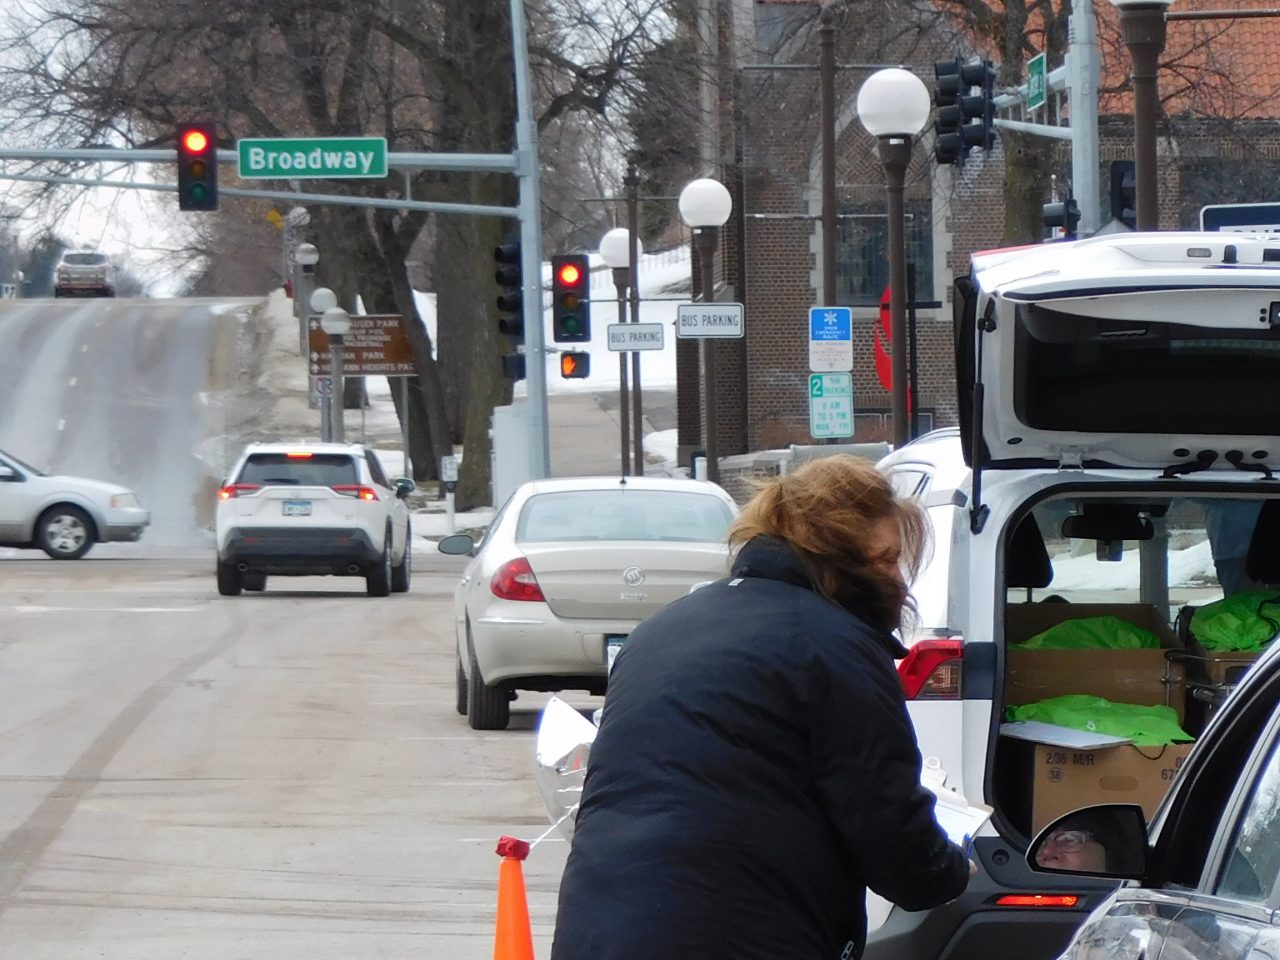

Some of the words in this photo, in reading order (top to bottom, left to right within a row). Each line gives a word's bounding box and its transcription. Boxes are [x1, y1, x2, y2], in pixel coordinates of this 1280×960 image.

[249, 147, 375, 173] Broadway
[680, 315, 698, 327] BUS
[702, 314, 739, 327] PARKING
[611, 333, 626, 343] BUS
[629, 331, 660, 343] PARKING
[812, 379, 822, 395] 2
